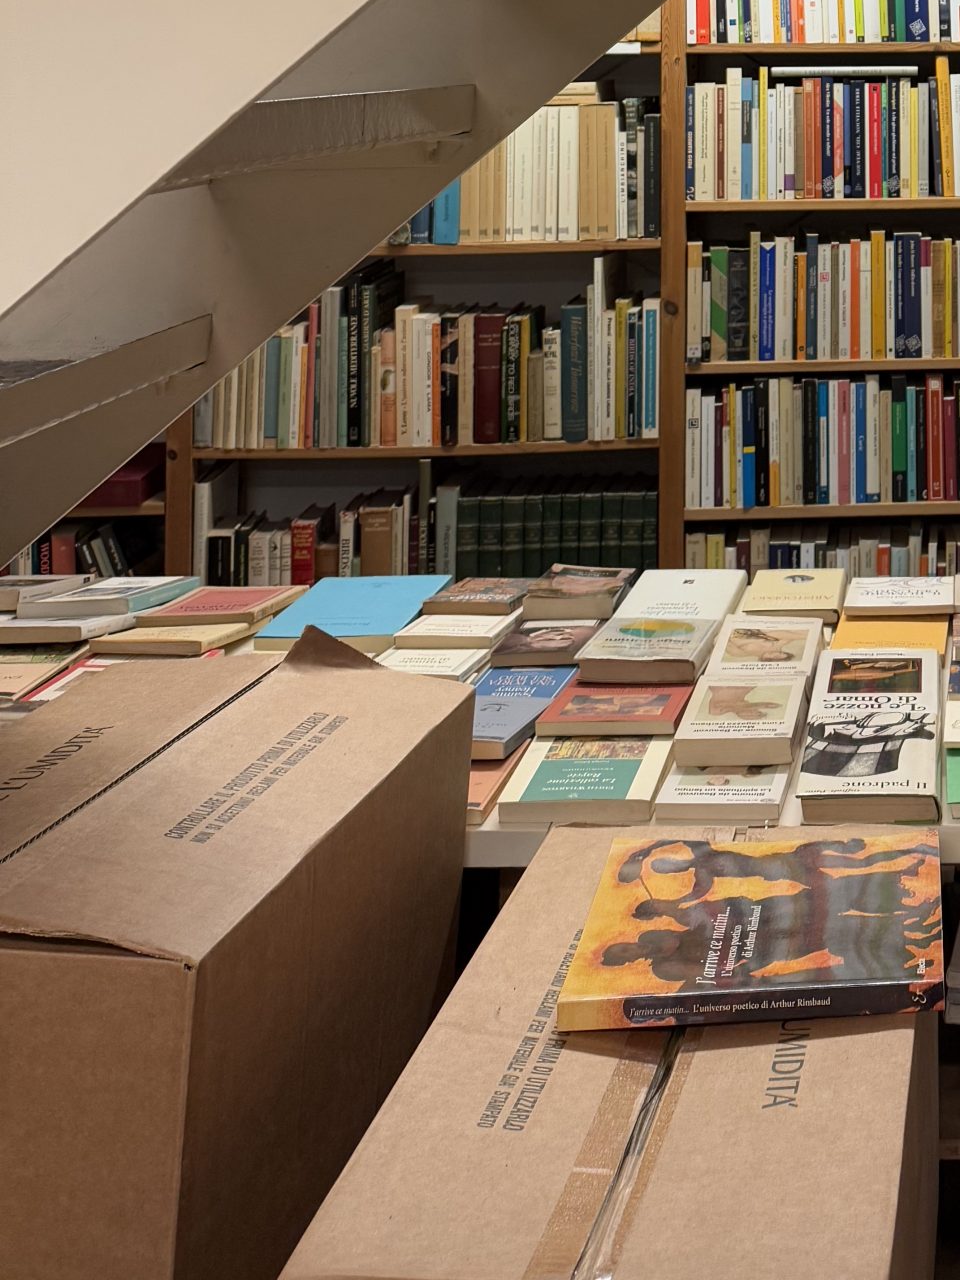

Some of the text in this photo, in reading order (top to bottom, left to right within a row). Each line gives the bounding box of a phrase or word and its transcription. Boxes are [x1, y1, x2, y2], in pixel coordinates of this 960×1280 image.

[349, 315, 358, 408] NUVOLE MEDITERRANEE
[570, 366, 582, 414] Tomorrow
[340, 538, 349, 568] BIRDS
[822, 695, 918, 704] di Omar
[823, 702, 926, 712] Le nozze
[163, 796, 227, 840] CONTROLLARE
[222, 762, 269, 792] PRODOTTO
[255, 746, 288, 764] PRIMA
[283, 711, 330, 744] UTILIZZARLO
[189, 832, 215, 845] NON
[213, 796, 256, 826] ACCETTANO
[245, 776, 280, 798] RECLAMI
[280, 742, 318, 768] MATERIALE
[317, 714, 350, 736] STAMPATO
[546, 777, 599, 786] collezione
[841, 779, 928, 790] Il padrone
[747, 905, 762, 931] Rimbaud
[696, 906, 731, 985] J'arrive ce matin...
[721, 924, 742, 977] L'universo poetico
[743, 931, 757, 951] Arthur
[535, 989, 561, 1019] RECLAMI
[629, 996, 832, 1018] J'arrive ce matin... L'universo poetico di Arthur Rimbaud
[526, 1019, 548, 1034] PER
[506, 1035, 539, 1073] MATERIALE
[535, 1037, 567, 1064] PRIMA
[529, 1065, 554, 1077] DI
[476, 1090, 511, 1129] STAMPATO
[502, 1076, 547, 1132] UTILIZZARLO
